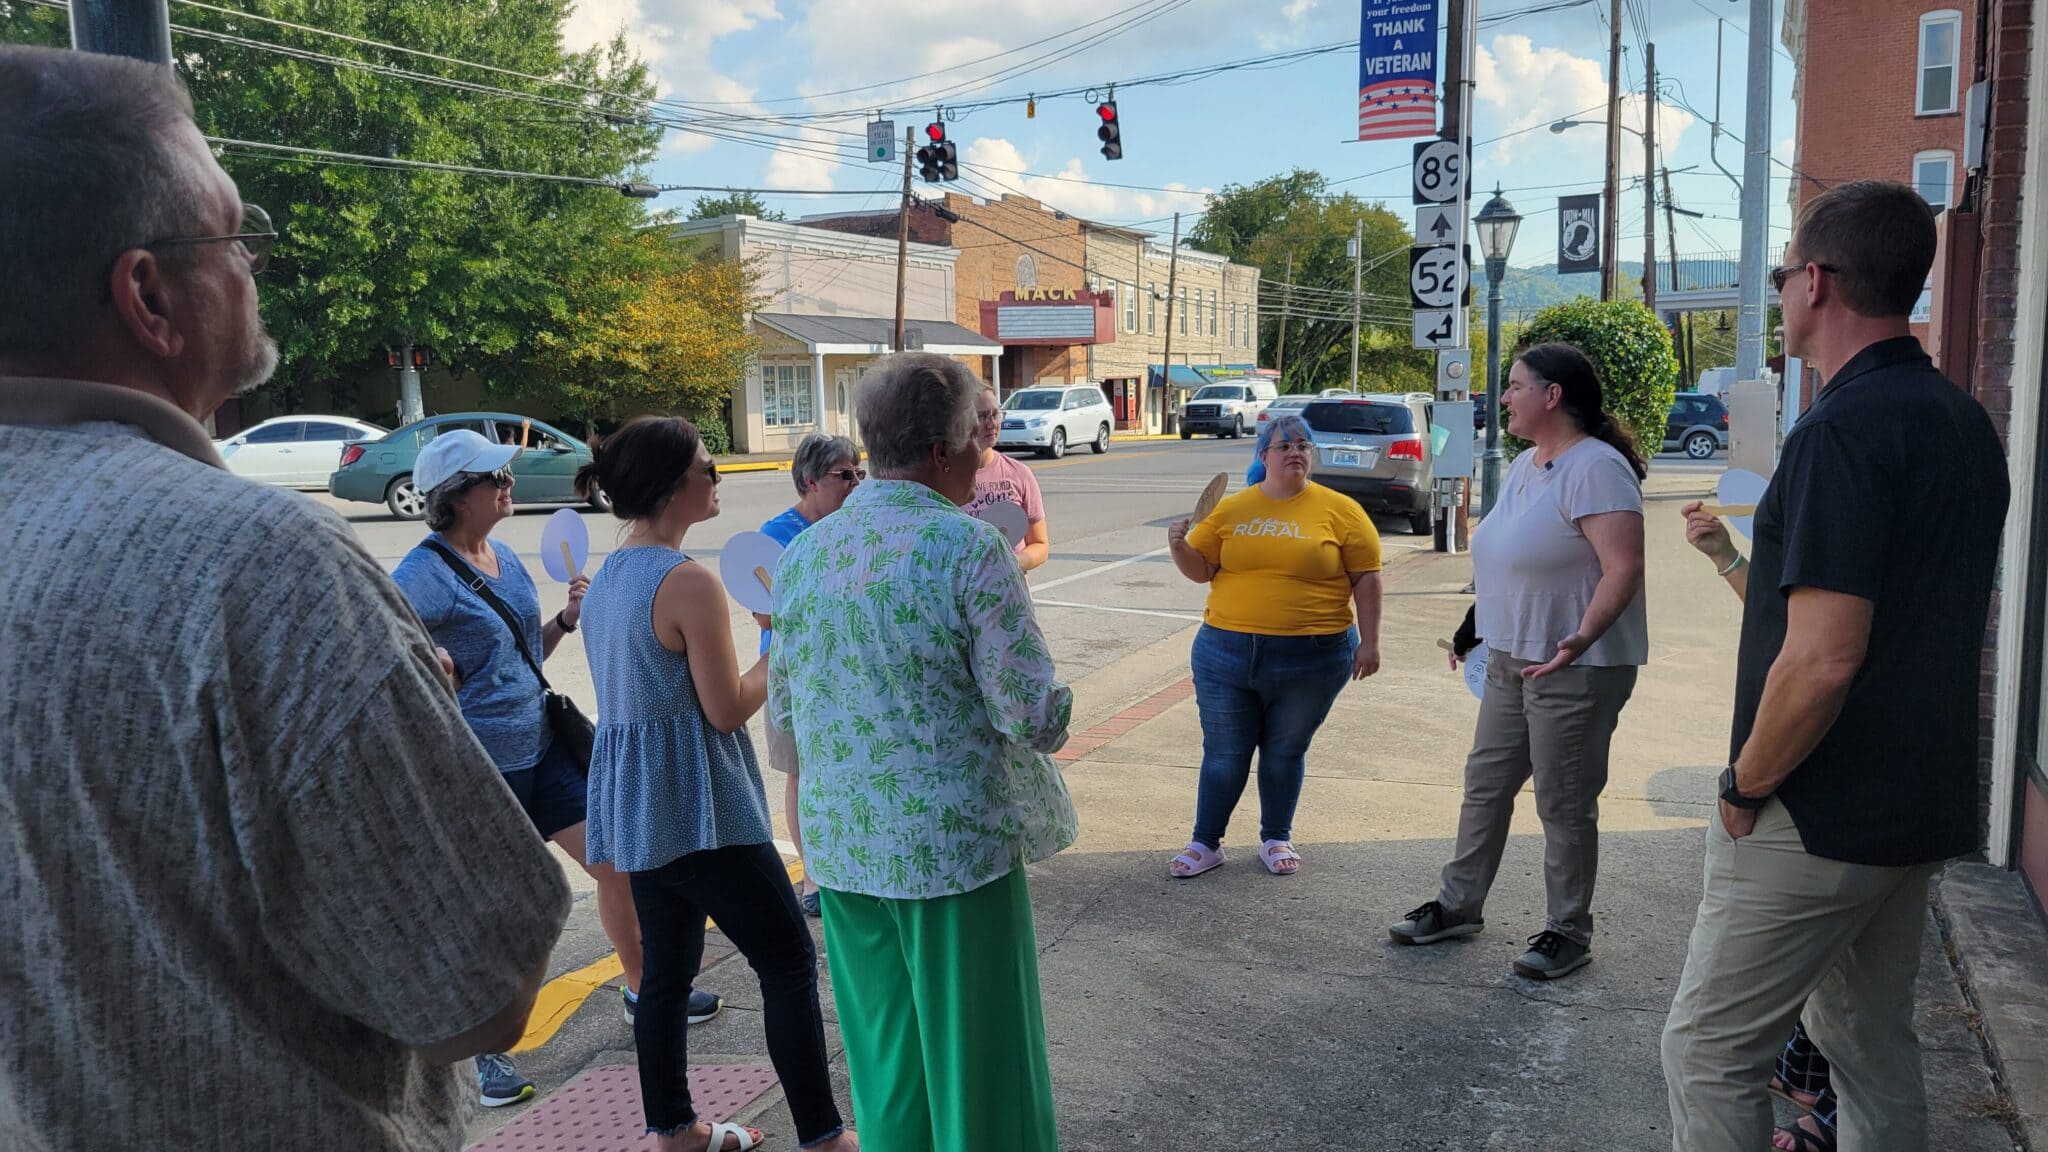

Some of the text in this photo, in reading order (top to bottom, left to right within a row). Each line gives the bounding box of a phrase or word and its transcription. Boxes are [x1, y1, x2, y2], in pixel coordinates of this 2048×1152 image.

[1367, 3, 1431, 20] your freedom
[1373, 18, 1425, 37] THANK
[1393, 40, 1403, 51] A
[1366, 51, 1431, 76] VETERAN
[1421, 154, 1459, 190] 89
[1418, 260, 1455, 294] 52
[1014, 284, 1076, 301] MACK
[976, 482, 987, 491] AVE
